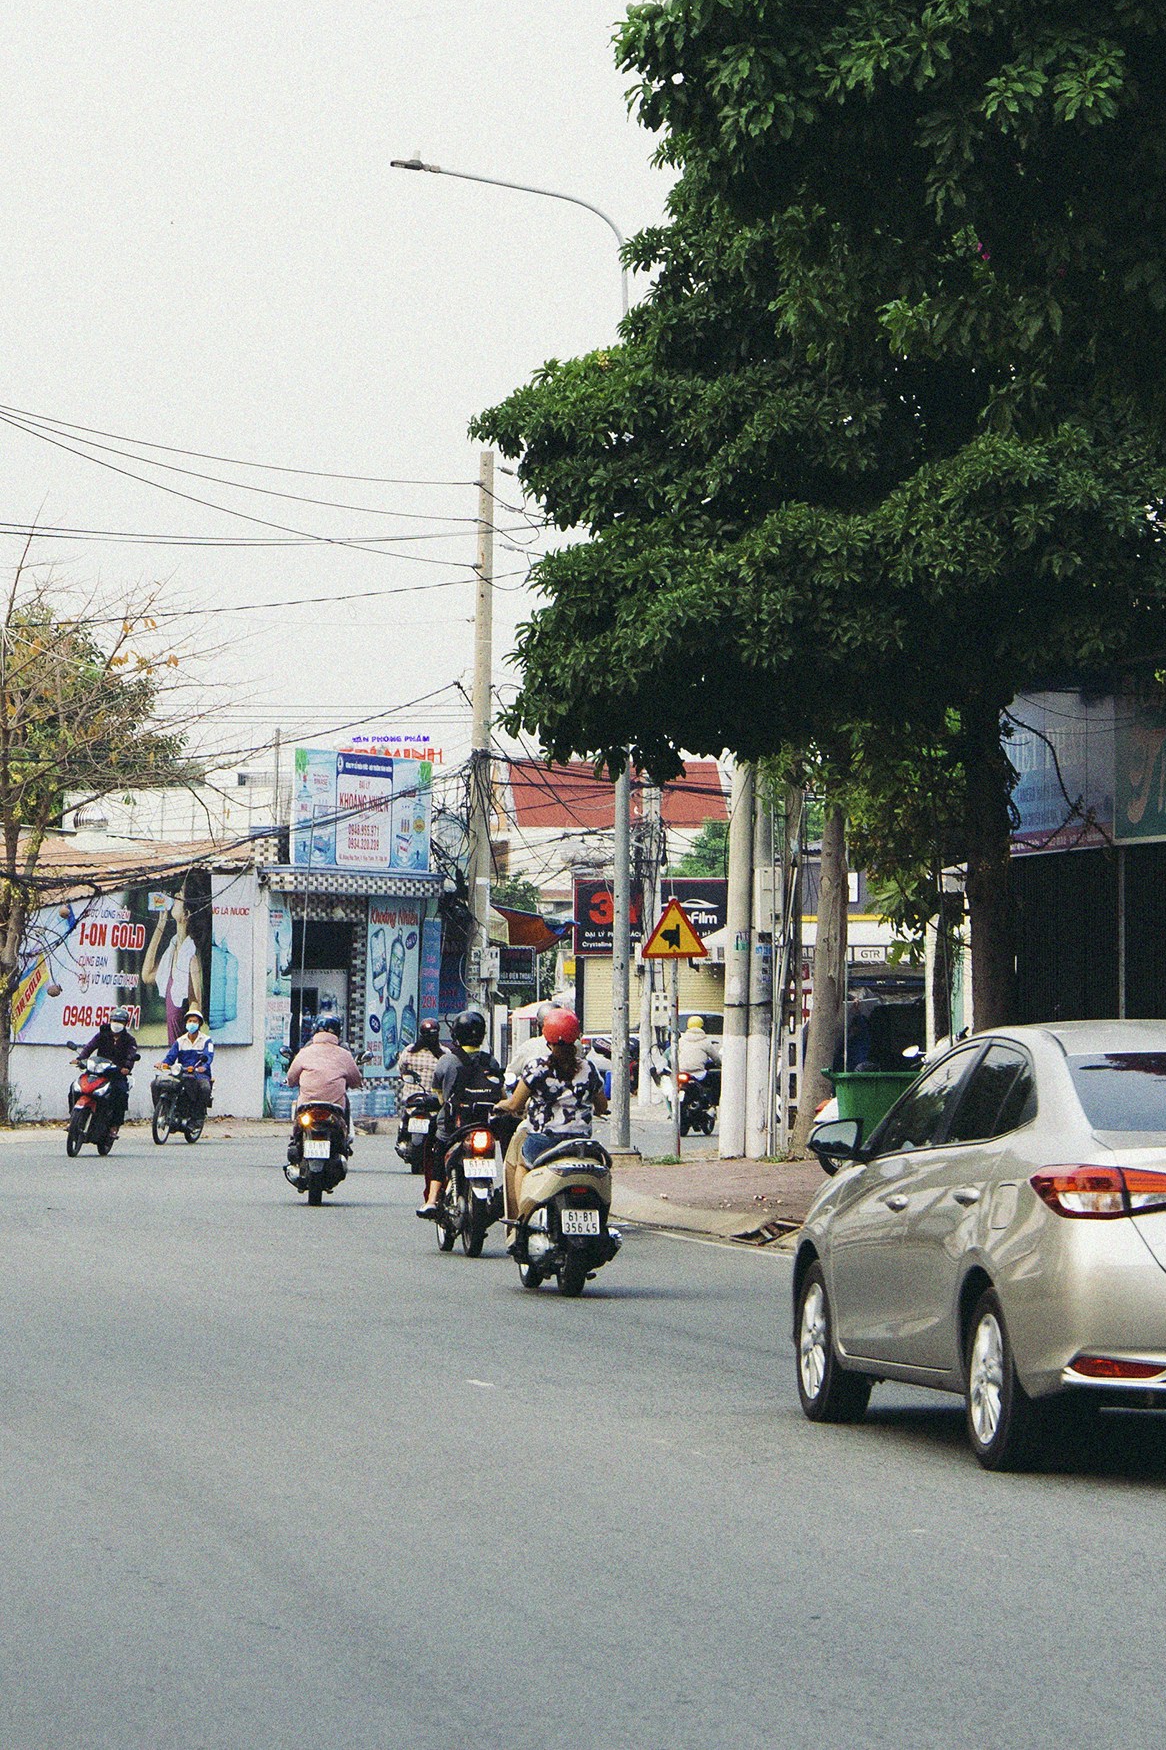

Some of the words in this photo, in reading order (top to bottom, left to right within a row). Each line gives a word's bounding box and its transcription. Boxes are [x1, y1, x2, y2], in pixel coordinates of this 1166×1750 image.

[111, 924, 144, 948] GOLD
[860, 950, 881, 959] GTR
[568, 1211, 593, 1222] 61-B1
[565, 1223, 597, 1234] 356.45
